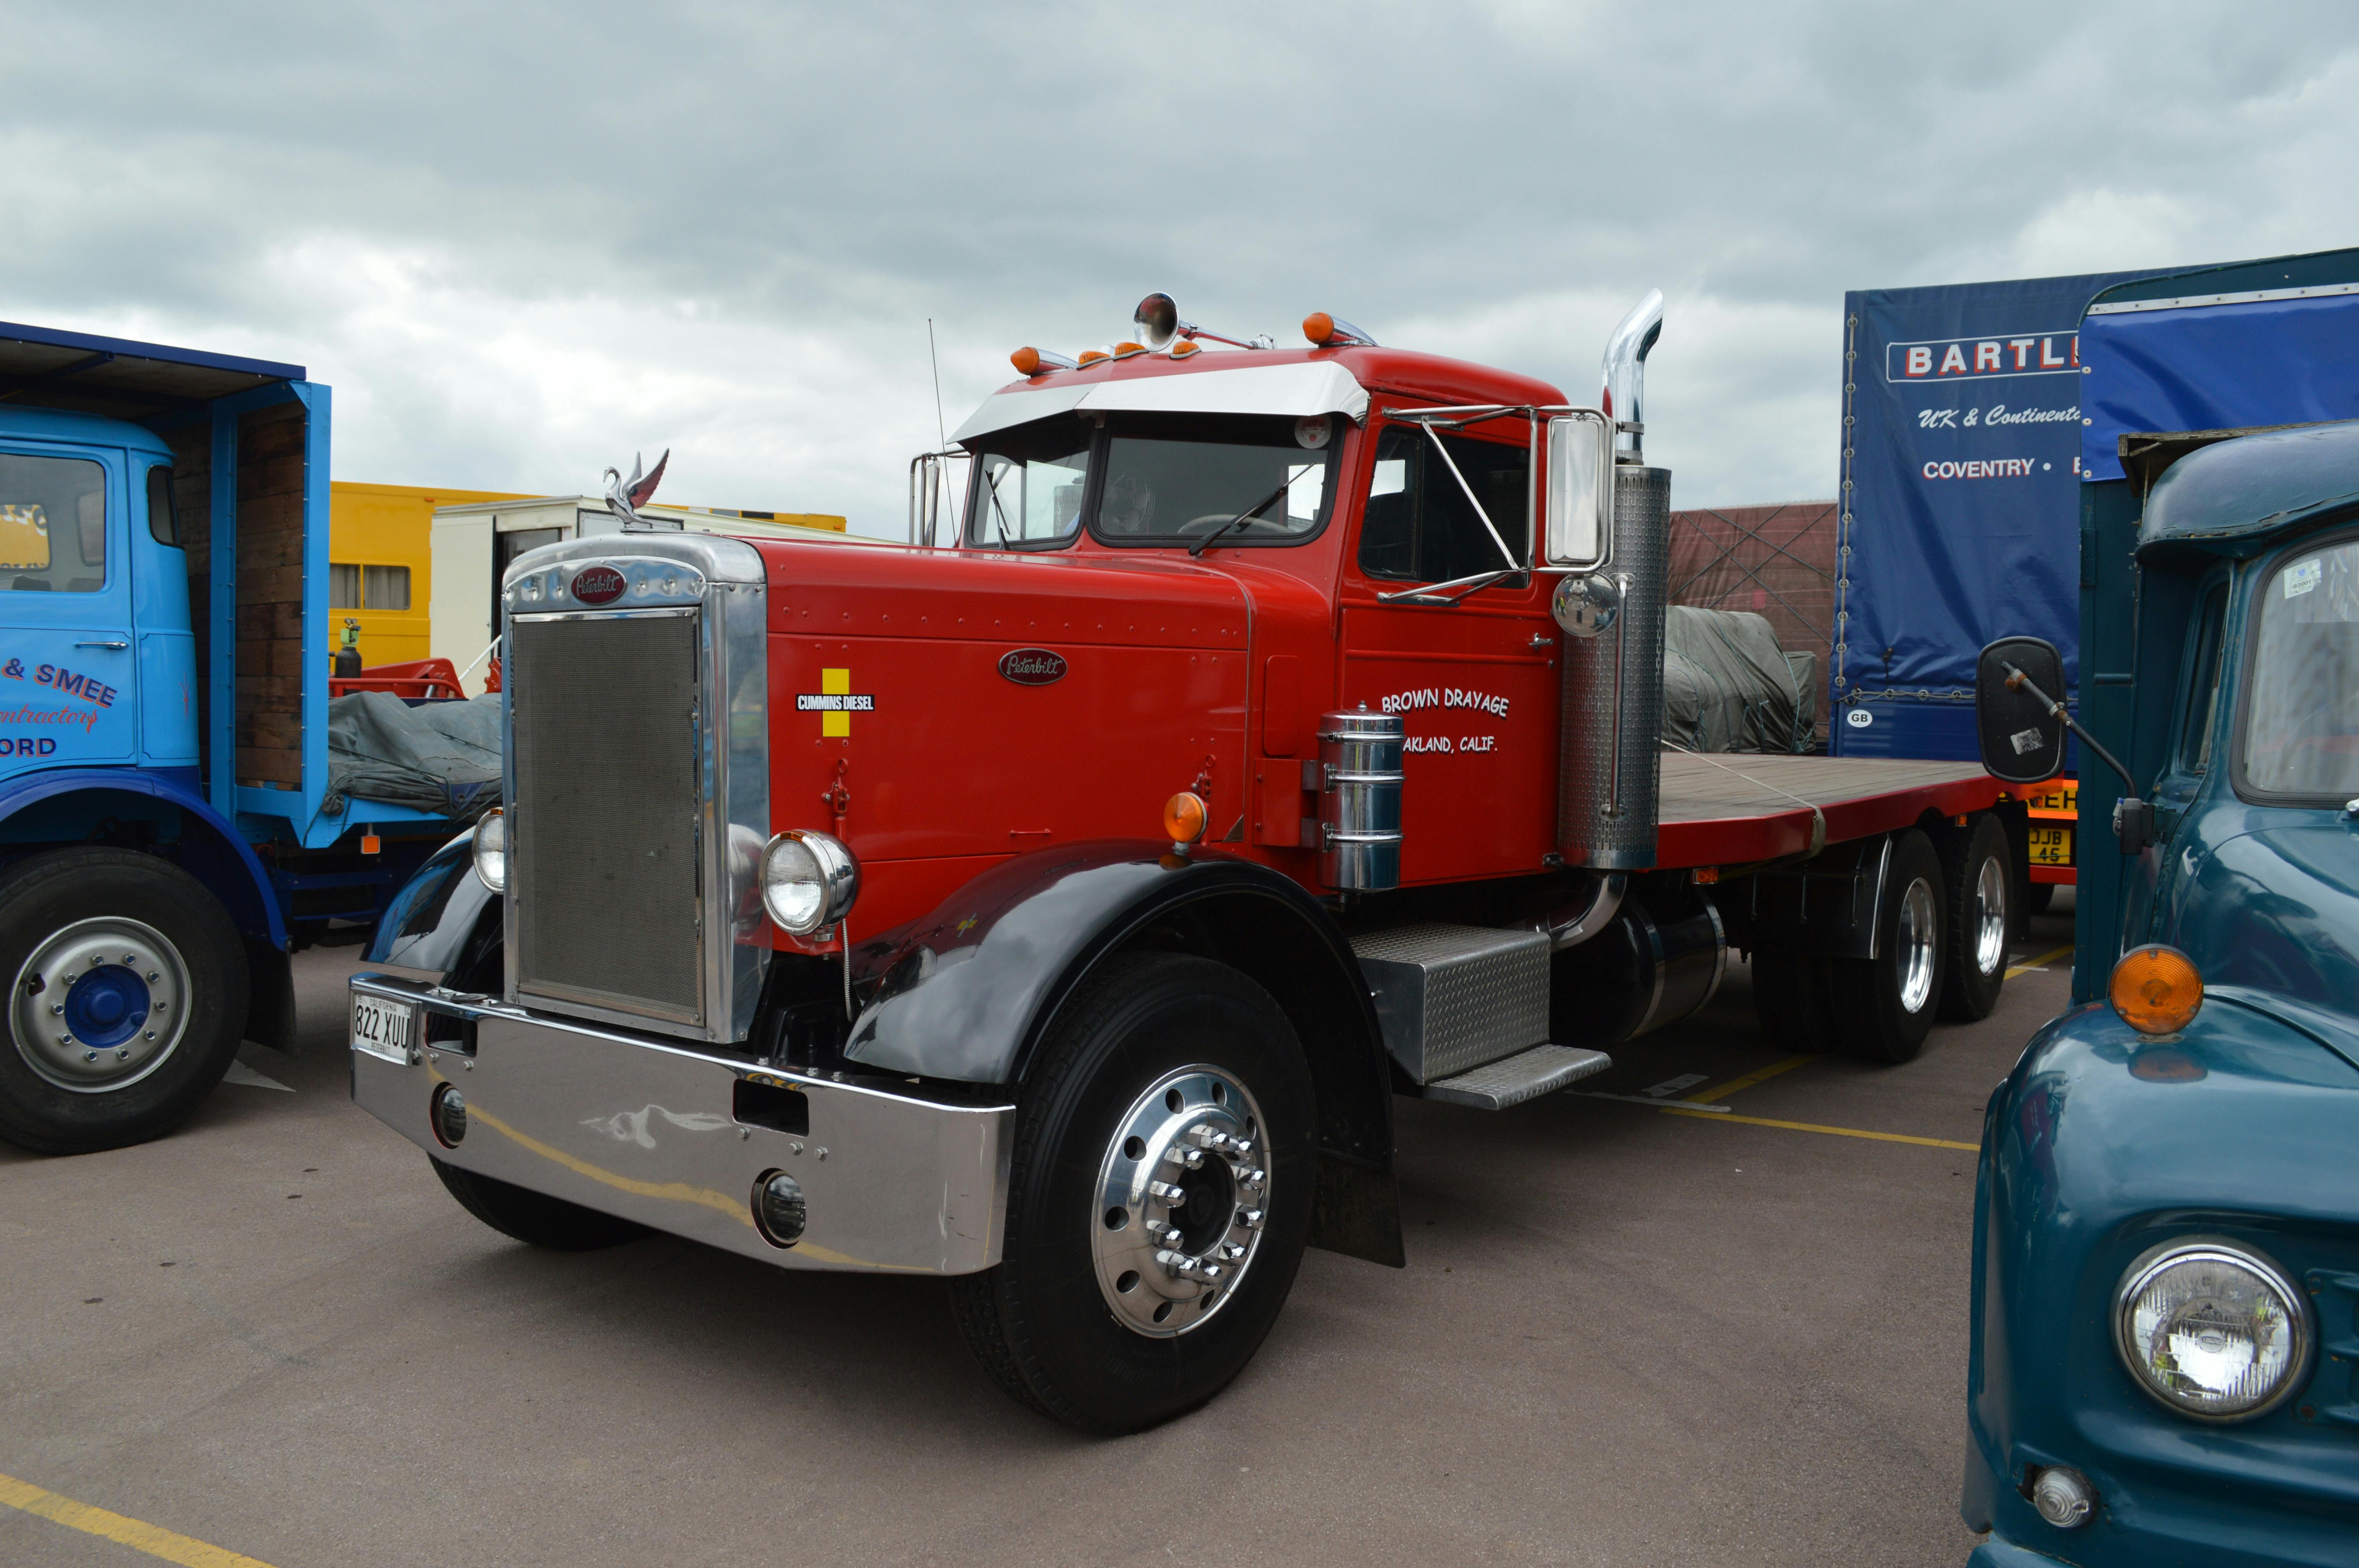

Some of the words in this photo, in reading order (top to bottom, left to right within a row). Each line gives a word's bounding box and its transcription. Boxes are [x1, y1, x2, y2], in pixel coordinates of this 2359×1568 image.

[1918, 409, 1960, 428] UK
[1963, 408, 1979, 426] &
[1923, 458, 2035, 479] COVENTRY
[576, 573, 620, 597] Peterbilt
[1007, 655, 1063, 675] Peterbilt
[2, 658, 25, 681] &
[33, 664, 118, 709] SMEE
[798, 695, 842, 710] CUMMINS
[843, 695, 874, 710] DIESEL
[1381, 688, 1439, 713] BROWN
[1444, 688, 1509, 717] DRAYAGE
[1851, 713, 1868, 722] GB
[0, 738, 57, 757] ORD
[1403, 736, 1454, 754] AKLAND,
[1459, 735, 1498, 751] CALIF.
[2039, 847, 2060, 862] 45
[370, 998, 397, 1012] CALIFORNIA
[356, 1004, 379, 1041] 822
[383, 1012, 410, 1049] XUU
[371, 1042, 391, 1054] PETERBILT
